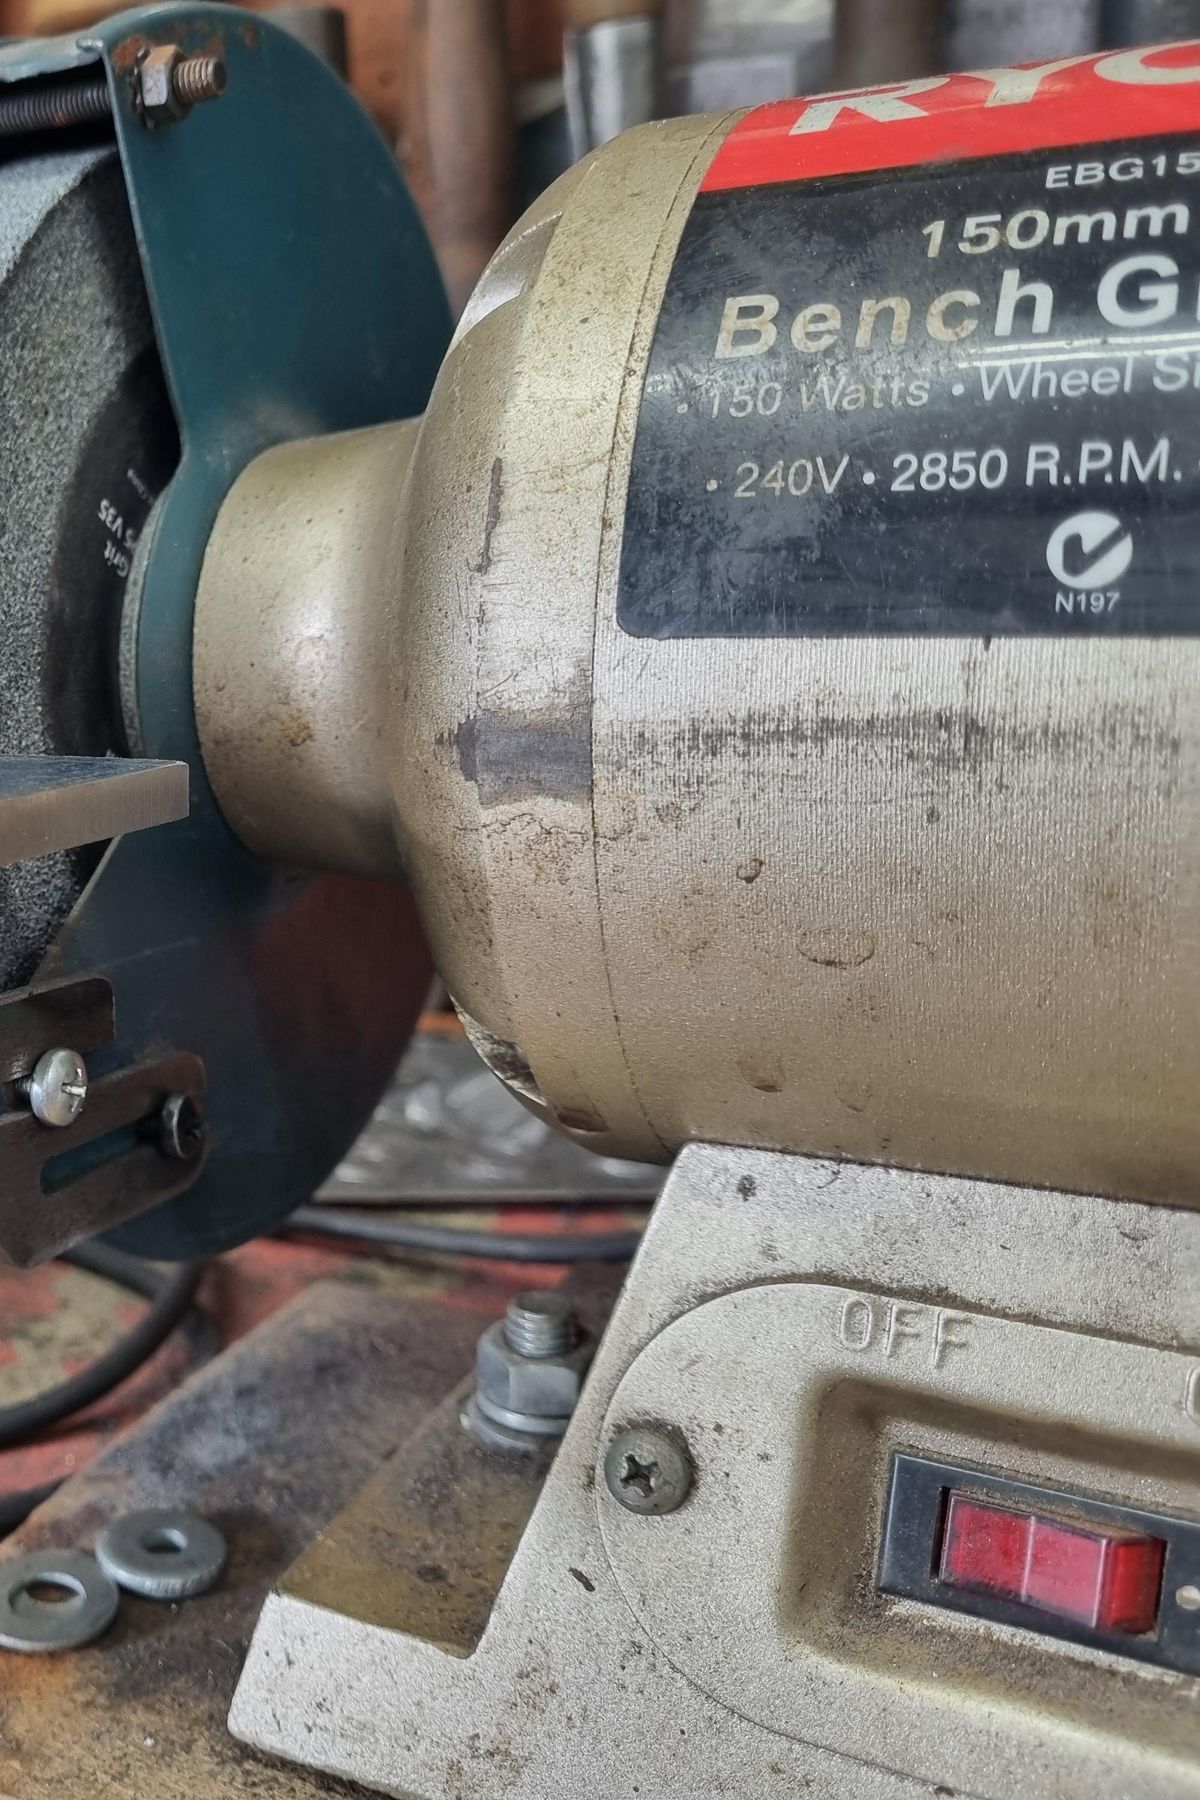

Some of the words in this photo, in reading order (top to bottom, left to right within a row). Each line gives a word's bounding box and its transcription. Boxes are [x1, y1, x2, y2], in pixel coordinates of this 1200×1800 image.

[921, 202, 1190, 259] 150mm
[714, 268, 1054, 360] Bench
[1097, 254, 1200, 328] G
[710, 380, 782, 419] 150
[801, 373, 930, 413] Watts
[980, 355, 1133, 400] Wheel
[734, 455, 850, 499] 240V
[890, 449, 1007, 492] 2850
[1025, 437, 1182, 487] R.P.M.
[1054, 591, 1121, 614] N197
[839, 1298, 970, 1368] OFF
